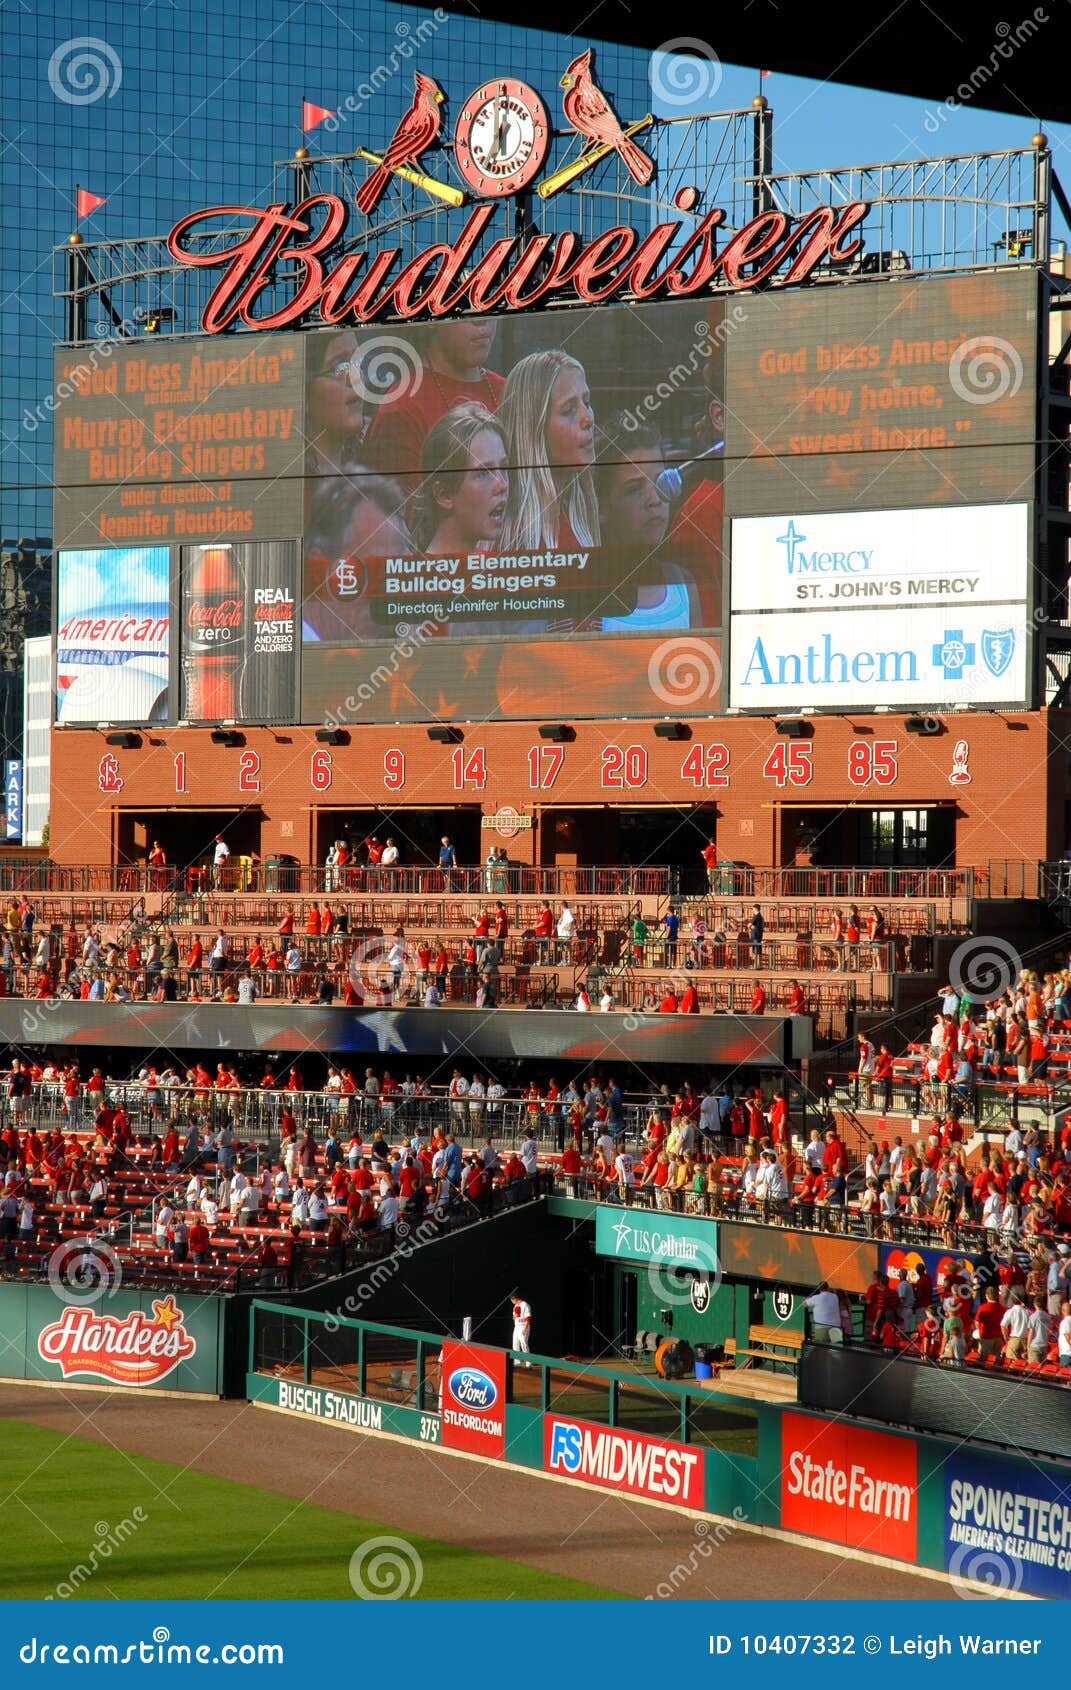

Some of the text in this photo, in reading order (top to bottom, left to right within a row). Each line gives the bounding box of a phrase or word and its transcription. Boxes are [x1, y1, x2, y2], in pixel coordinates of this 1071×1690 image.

[168, 187, 868, 334] Budweiser
[759, 347, 806, 375] God
[817, 344, 880, 371] bless
[125, 358, 181, 393] Bless
[64, 406, 295, 448] Murray Elementary
[88, 443, 266, 480] Bulldog Singers
[174, 506, 253, 536] Houchins
[385, 552, 589, 575] Murray Elementary
[254, 588, 294, 604] REAL
[385, 573, 556, 594] Bulldog Singers
[797, 577, 980, 600] ST. JOHN'S MERCY
[188, 599, 244, 628] Coca-Cola
[446, 599, 499, 614] Jennifer
[503, 597, 565, 611] Houchins
[57, 613, 170, 643] American
[198, 627, 231, 641] zero
[254, 621, 294, 634] TASTE
[255, 635, 293, 644] AND ZERO
[254, 644, 293, 652] CALORIES
[740, 633, 920, 685] Anthem
[174, 752, 186, 792] 1
[239, 751, 261, 791] 2
[311, 750, 332, 790] 6
[384, 749, 405, 789] 9
[452, 748, 486, 789] 14
[528, 746, 564, 788] 17
[602, 745, 648, 787] 20
[682, 744, 730, 787] 42
[763, 743, 812, 786] 45
[848, 741, 897, 785] 85
[7, 761, 19, 822] PARK
[651, 1232, 699, 1260] Cellular
[457, 1372, 488, 1405] Ford
[279, 1381, 383, 1430] BUSCH STADIUM
[420, 1417, 440, 1442] 375'
[443, 1408, 503, 1437] STLFORD.COM
[949, 1479, 1071, 1548] SPONGETECH
[949, 1522, 1004, 1553] AMERICA'S
[1004, 1535, 1056, 1567] CLEANING
